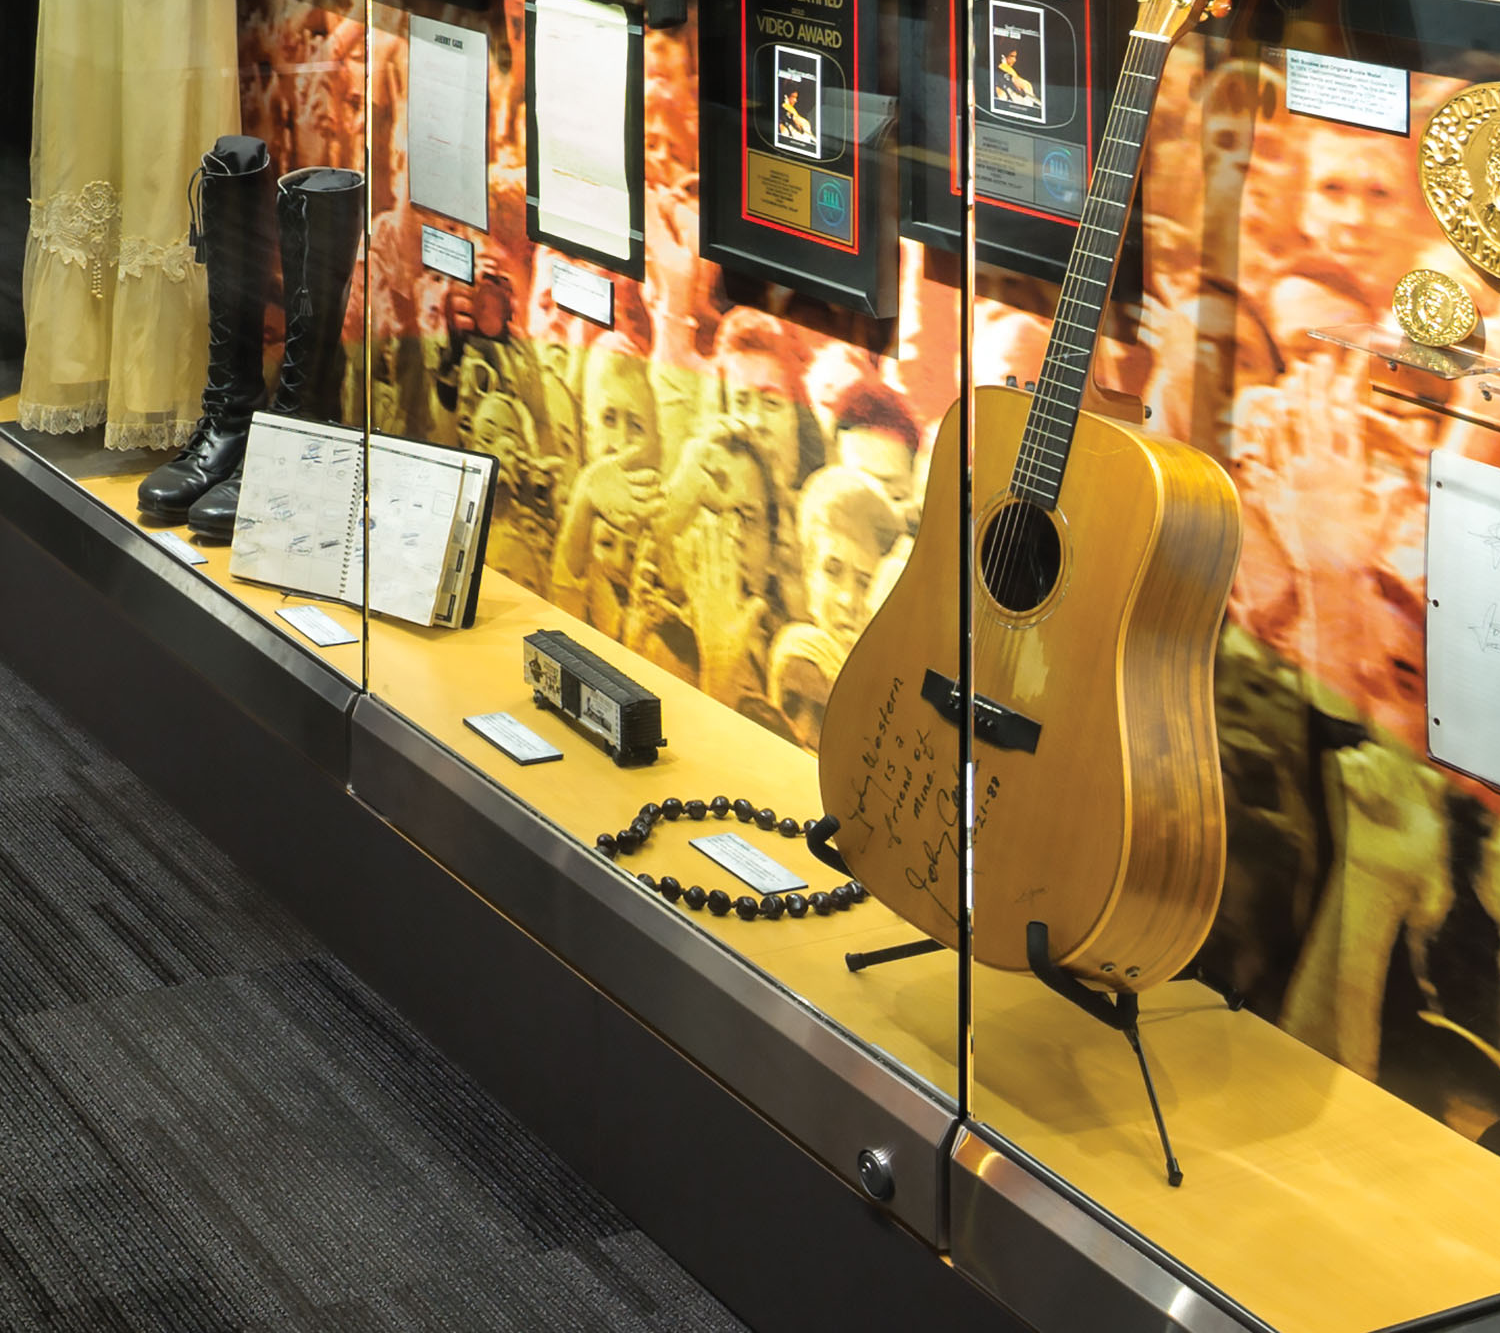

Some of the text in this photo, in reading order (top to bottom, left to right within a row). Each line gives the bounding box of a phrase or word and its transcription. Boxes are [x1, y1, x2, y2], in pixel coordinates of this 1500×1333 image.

[756, 14, 843, 49] VIDEO AWARD
[822, 188, 840, 209] RIAA
